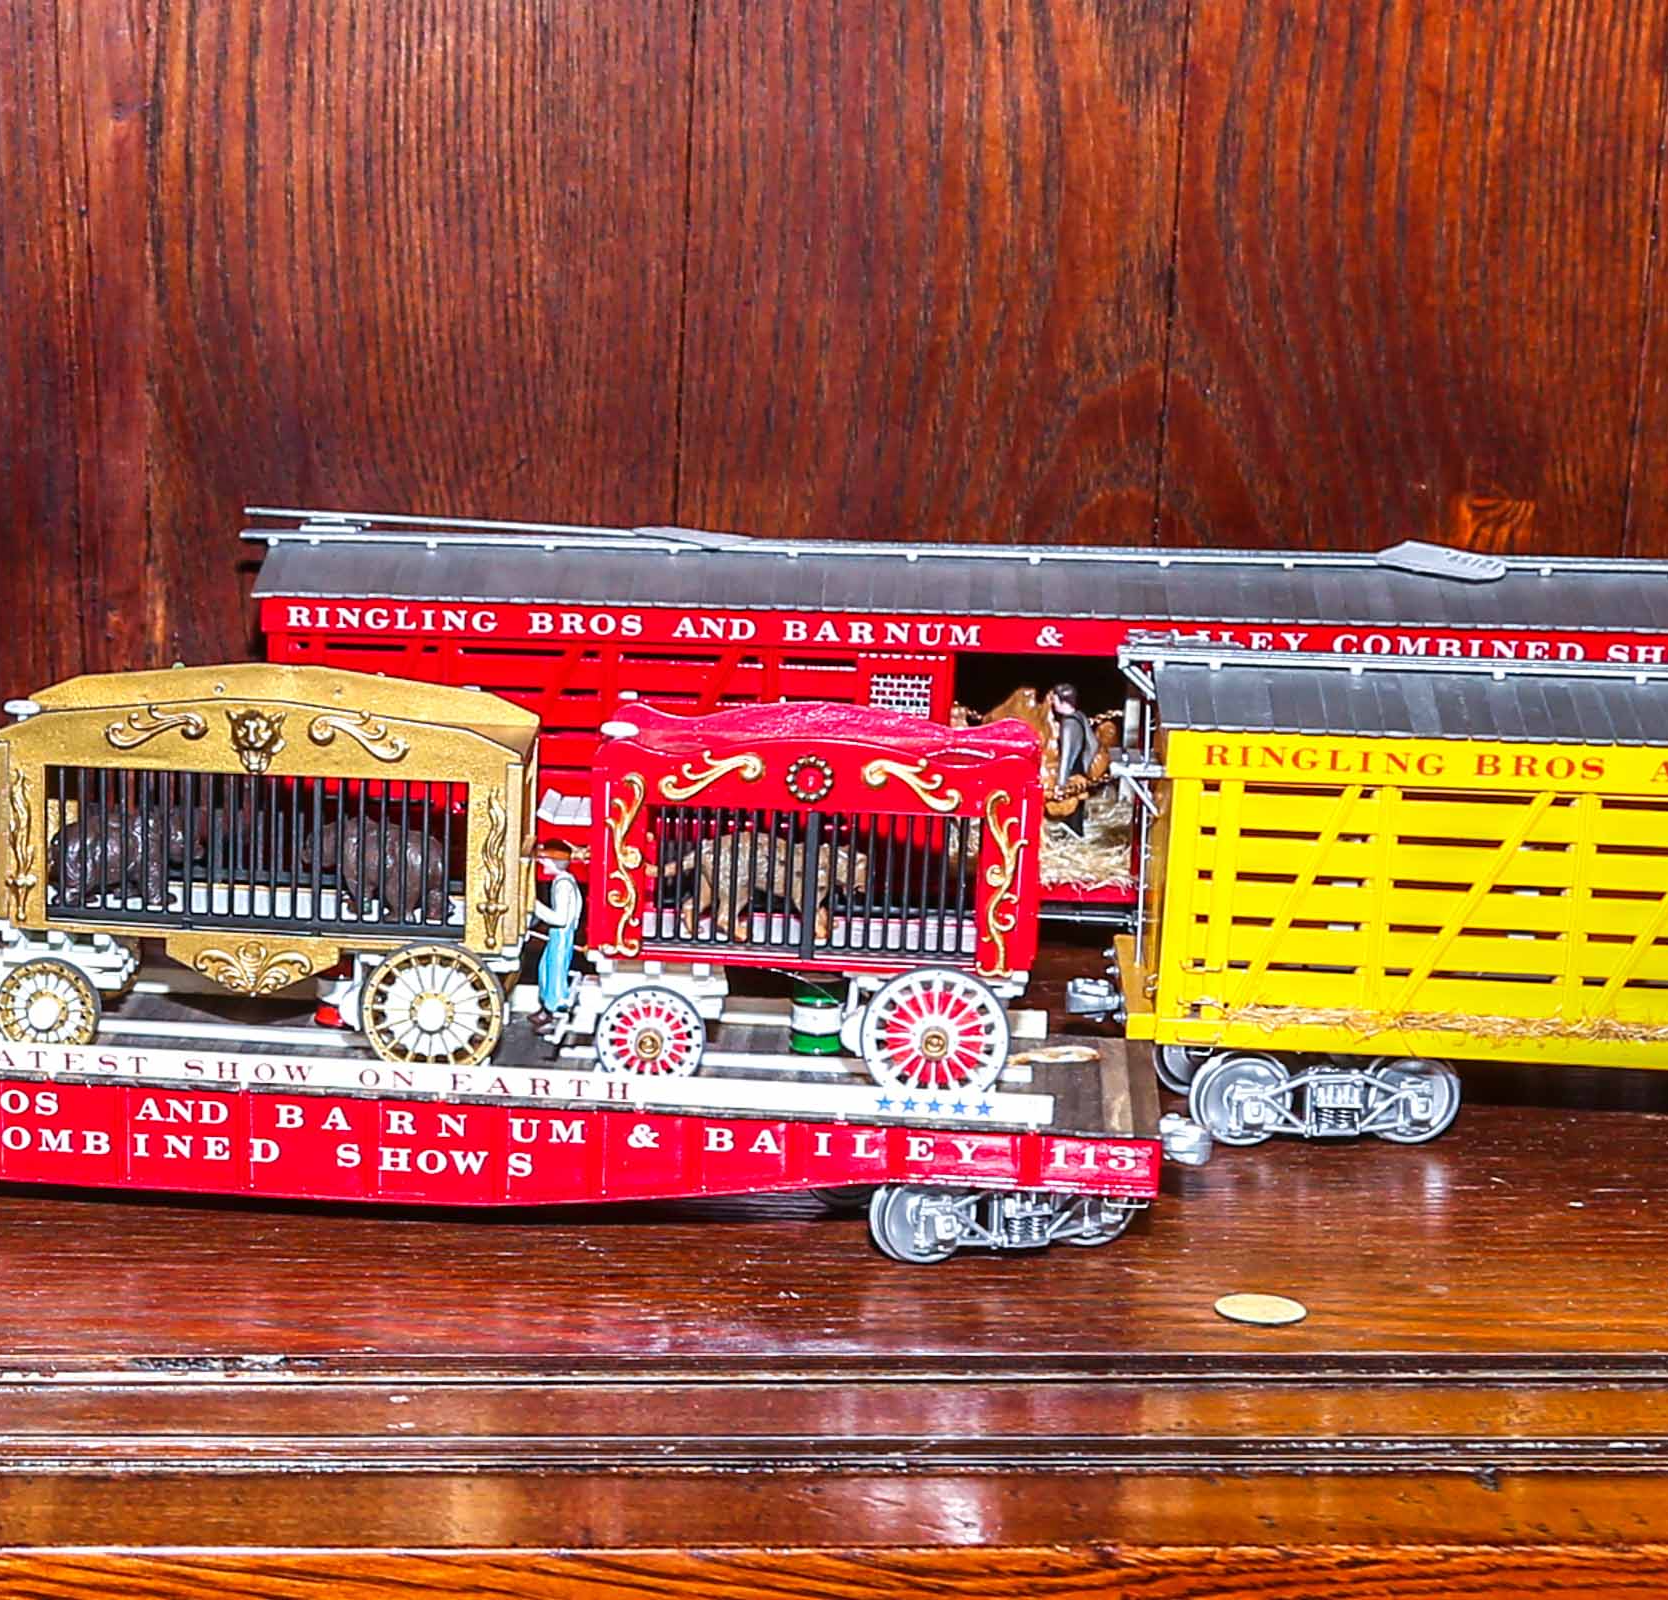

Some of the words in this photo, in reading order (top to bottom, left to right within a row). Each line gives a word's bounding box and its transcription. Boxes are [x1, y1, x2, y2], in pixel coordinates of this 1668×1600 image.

[288, 606, 497, 633] RINGLING
[529, 611, 642, 637] BROS
[673, 617, 755, 641] AND
[784, 620, 980, 645] BARNUM
[1036, 627, 1063, 647] &
[1203, 743, 1445, 777] RINGLING
[1473, 754, 1605, 781] BROS
[185, 1058, 314, 1082] SHOW
[359, 1068, 414, 1086] ON
[451, 1073, 631, 1100] EARTH
[136, 1099, 228, 1124] AND
[276, 1104, 586, 1144] BARNUM
[627, 1124, 659, 1149] &
[705, 1127, 984, 1165] BAILEY
[1050, 1145, 1136, 1170] 113
[337, 1143, 533, 1176] SHOWS
